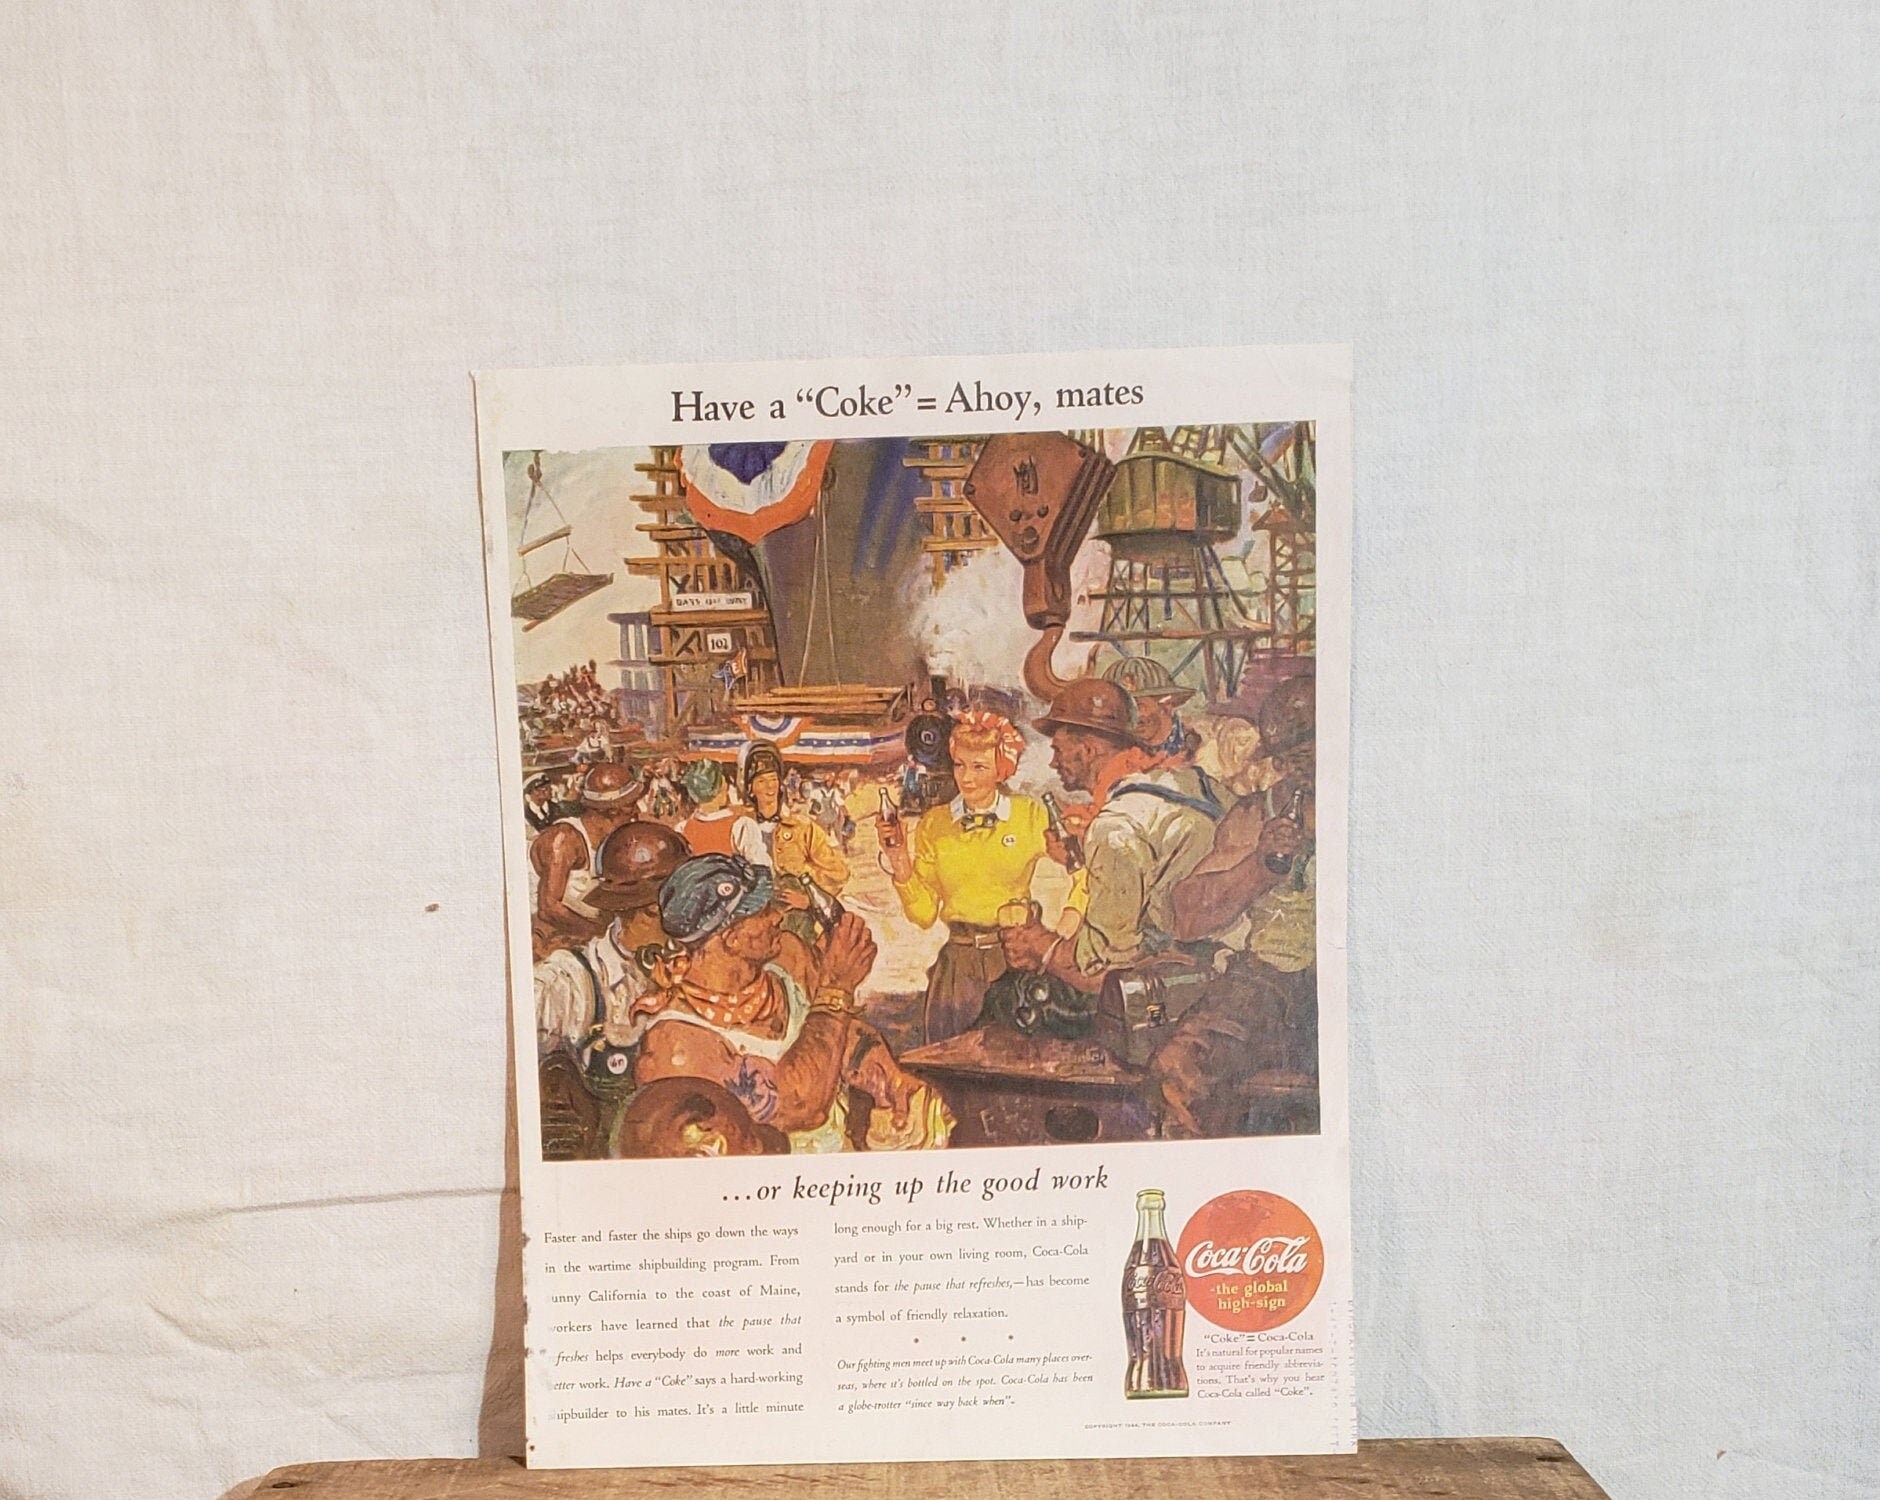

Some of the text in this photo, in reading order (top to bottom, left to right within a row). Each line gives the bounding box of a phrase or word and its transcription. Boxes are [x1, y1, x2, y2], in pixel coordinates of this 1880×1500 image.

[672, 390, 755, 422] Have
[769, 400, 786, 419] a
[797, 383, 911, 418] “Coke”
[945, 381, 1041, 420] Ahoy,
[1056, 382, 1144, 409] mates
[793, 1174, 882, 1206] keeping
[896, 1176, 924, 1203] up
[936, 1170, 971, 1195] the
[982, 1168, 1041, 1201] good
[1051, 1165, 1109, 1191] work
[544, 1225, 799, 1244] Faster and faster the ships go down the ways
[834, 1222, 858, 1237] long
[862, 1219, 901, 1236] enough
[906, 1220, 922, 1231] for
[925, 1222, 931, 1230] a
[936, 1220, 953, 1234] big
[957, 1220, 979, 1230] rest.
[983, 1216, 1032, 1229] Whether
[1036, 1216, 1047, 1227] in
[1061, 1215, 1088, 1230] ship-
[545, 1255, 799, 1274] in the wartime shipbuilding program. From
[834, 1245, 1088, 1267] yard or in your own living room, Coca-Cola
[1185, 1236, 1310, 1278] Coca-Cola
[834, 1281, 868, 1294] stands
[873, 1280, 889, 1292] for
[894, 1279, 909, 1292] the
[914, 1281, 941, 1295] pause
[946, 1278, 965, 1290] that
[1049, 1275, 1090, 1286] become
[1245, 1280, 1288, 1297] global
[551, 1285, 801, 1305] unny California to the coast of Maine,
[1218, 1296, 1286, 1313] high-sign
[601, 1313, 801, 1331] have learned that the pause that
[835, 1307, 1008, 1325] a symbol of friendly relaxation.
[1258, 1332, 1314, 1342] Coca-Cola
[595, 1343, 802, 1364] helps everybody do more work and
[837, 1352, 1093, 1372] Our fighting men meet up with Coca-Cola many places over-
[1212, 1347, 1243, 1356] natural
[1245, 1347, 1257, 1356] for
[1259, 1346, 1293, 1359] popular
[579, 1379, 610, 1389] work.
[614, 1377, 642, 1388] Have
[655, 1374, 693, 1387] “Coke”
[695, 1376, 716, 1388] says
[720, 1376, 727, 1384] a
[730, 1372, 803, 1386] hard-working
[837, 1372, 1093, 1392] seas, where it’s bottled on the spot. Coca-Cola has been
[1246, 1387, 1271, 1397] called
[617, 1402, 805, 1418] to his mates. It’s a little minute
[838, 1403, 844, 1411] a
[848, 1398, 901, 1414] globe-trotter
[906, 1398, 932, 1408] “since
[937, 1398, 954, 1409] way
[958, 1395, 978, 1407] back
